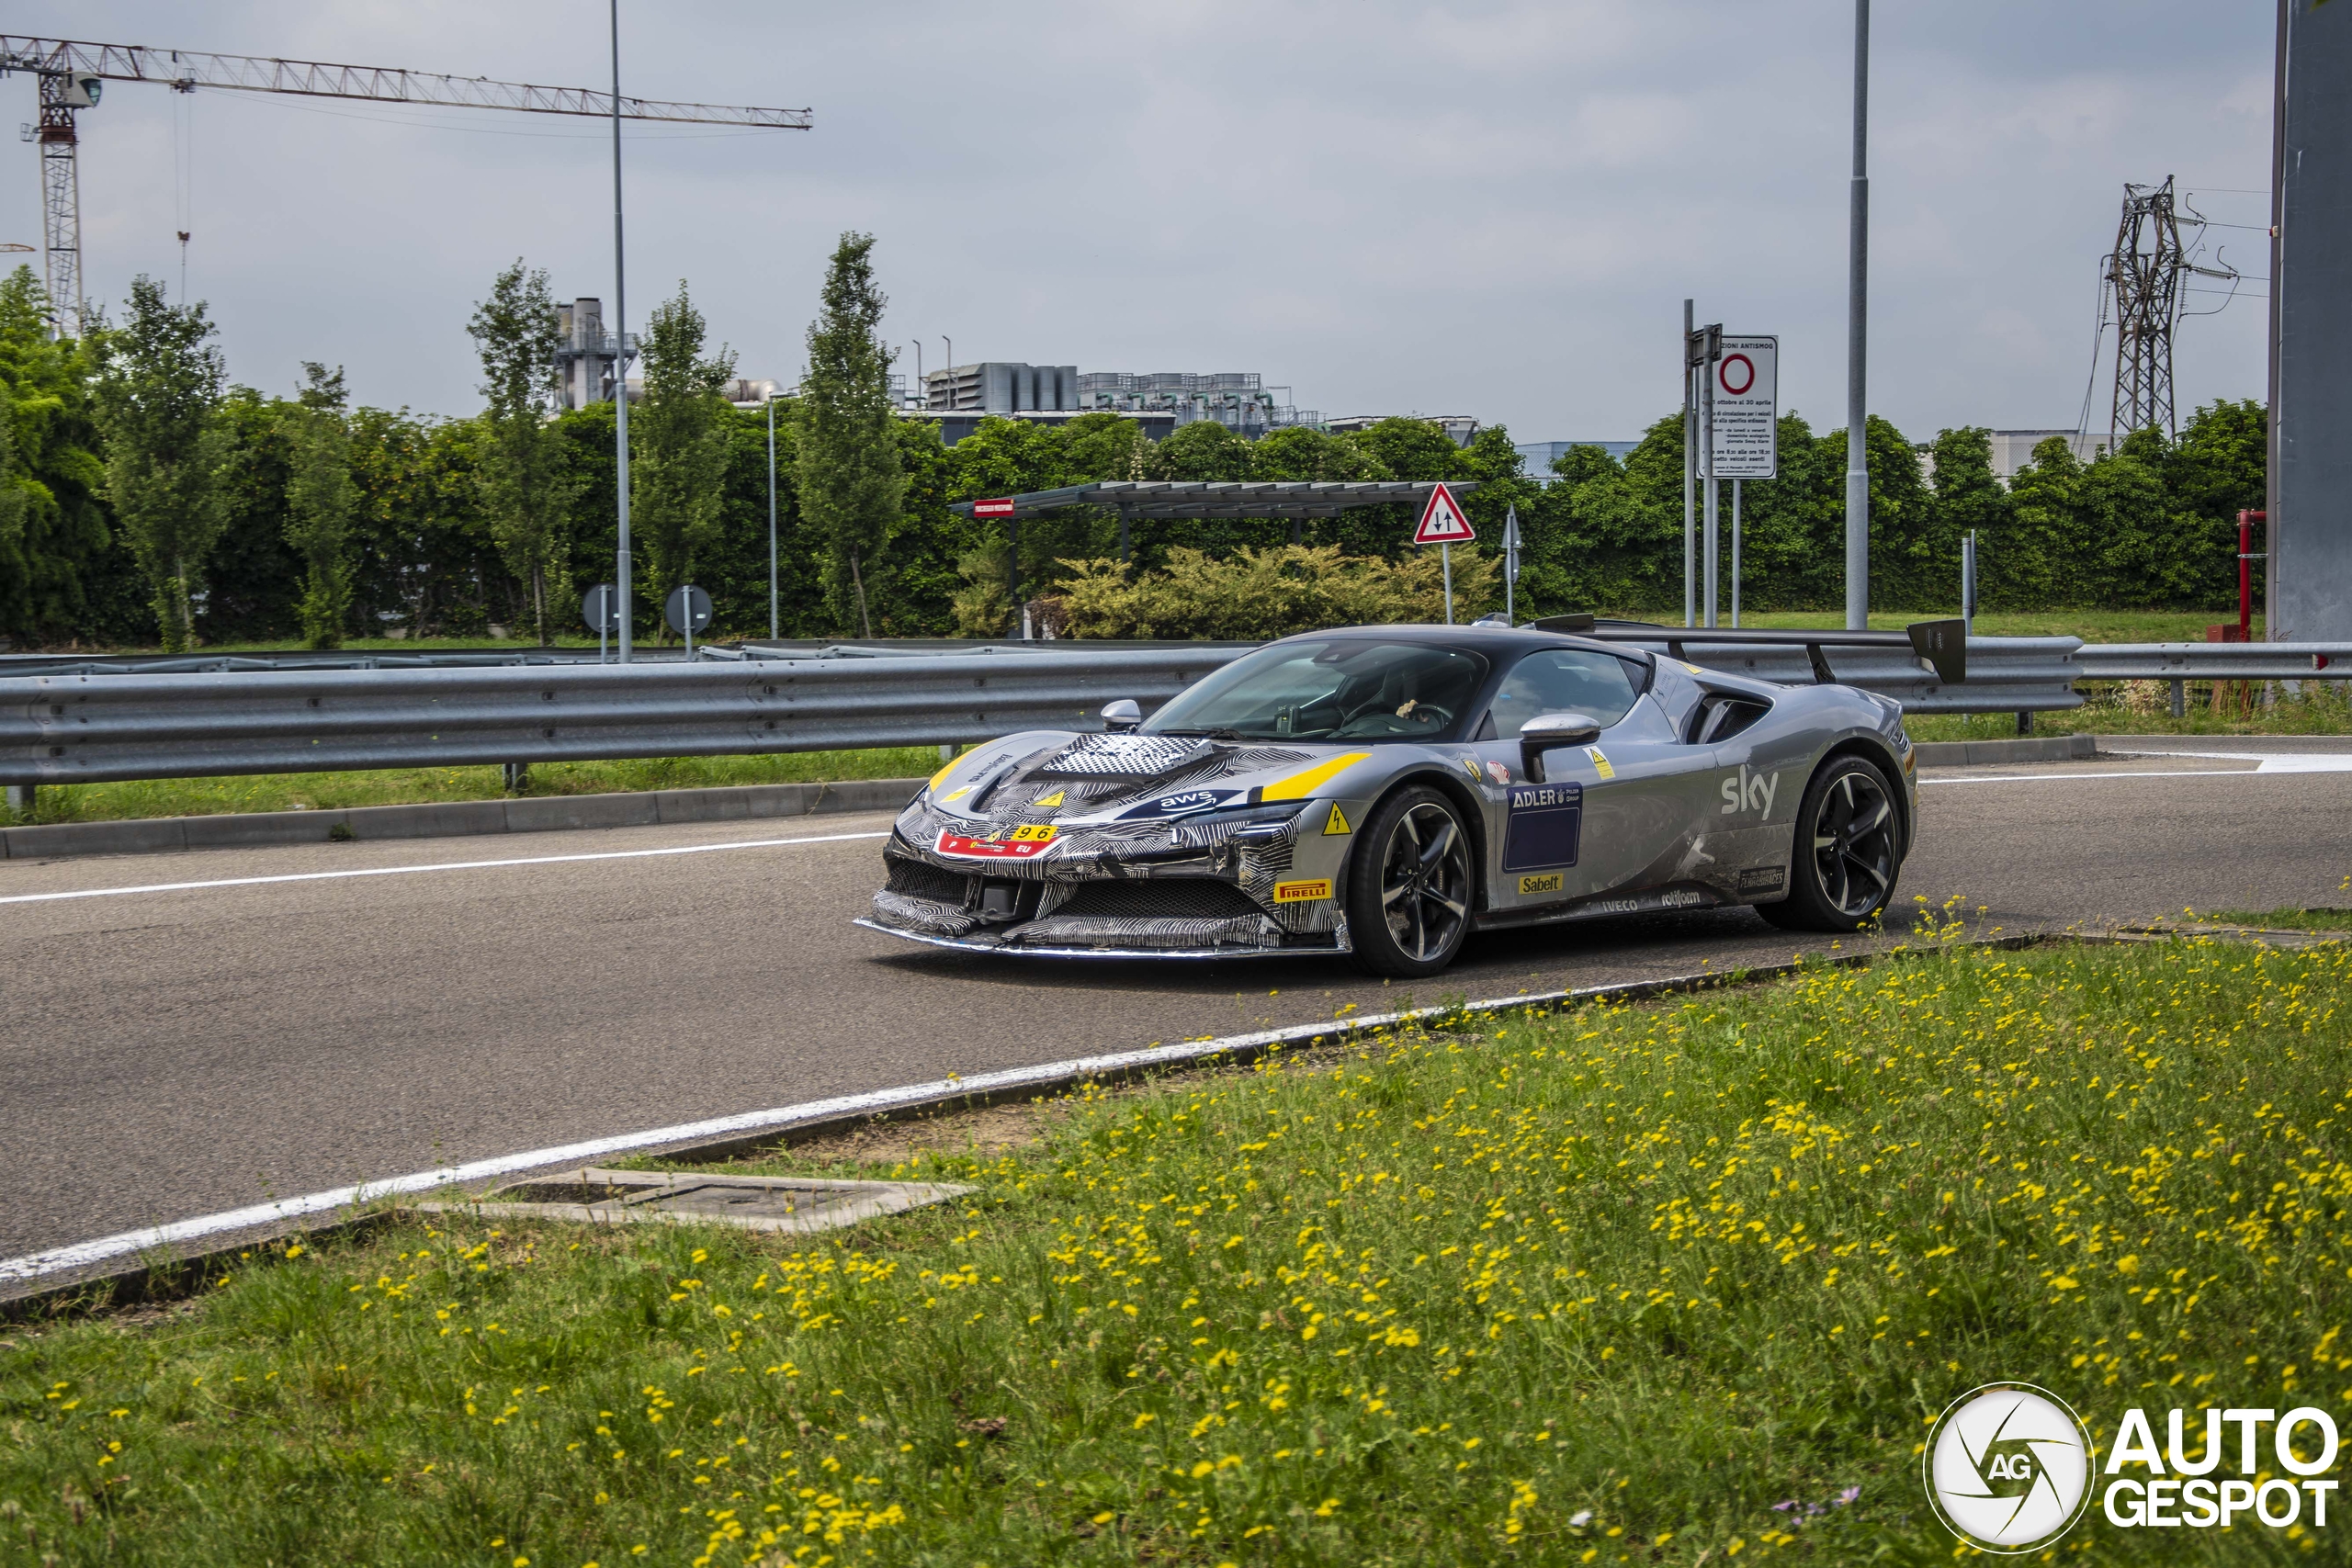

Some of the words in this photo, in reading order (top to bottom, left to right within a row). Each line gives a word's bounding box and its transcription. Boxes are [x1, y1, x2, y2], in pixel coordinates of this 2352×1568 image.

[1160, 791, 1213, 807] aws
[1512, 789, 1556, 808] ADLER
[1721, 763, 1779, 821] sky
[1015, 844, 1031, 853] EU
[1279, 883, 1326, 898] PIRELLI
[1522, 875, 1559, 892] Sabelt
[1602, 899, 1638, 912] IVECO
[1661, 889, 1701, 908] rotiform
